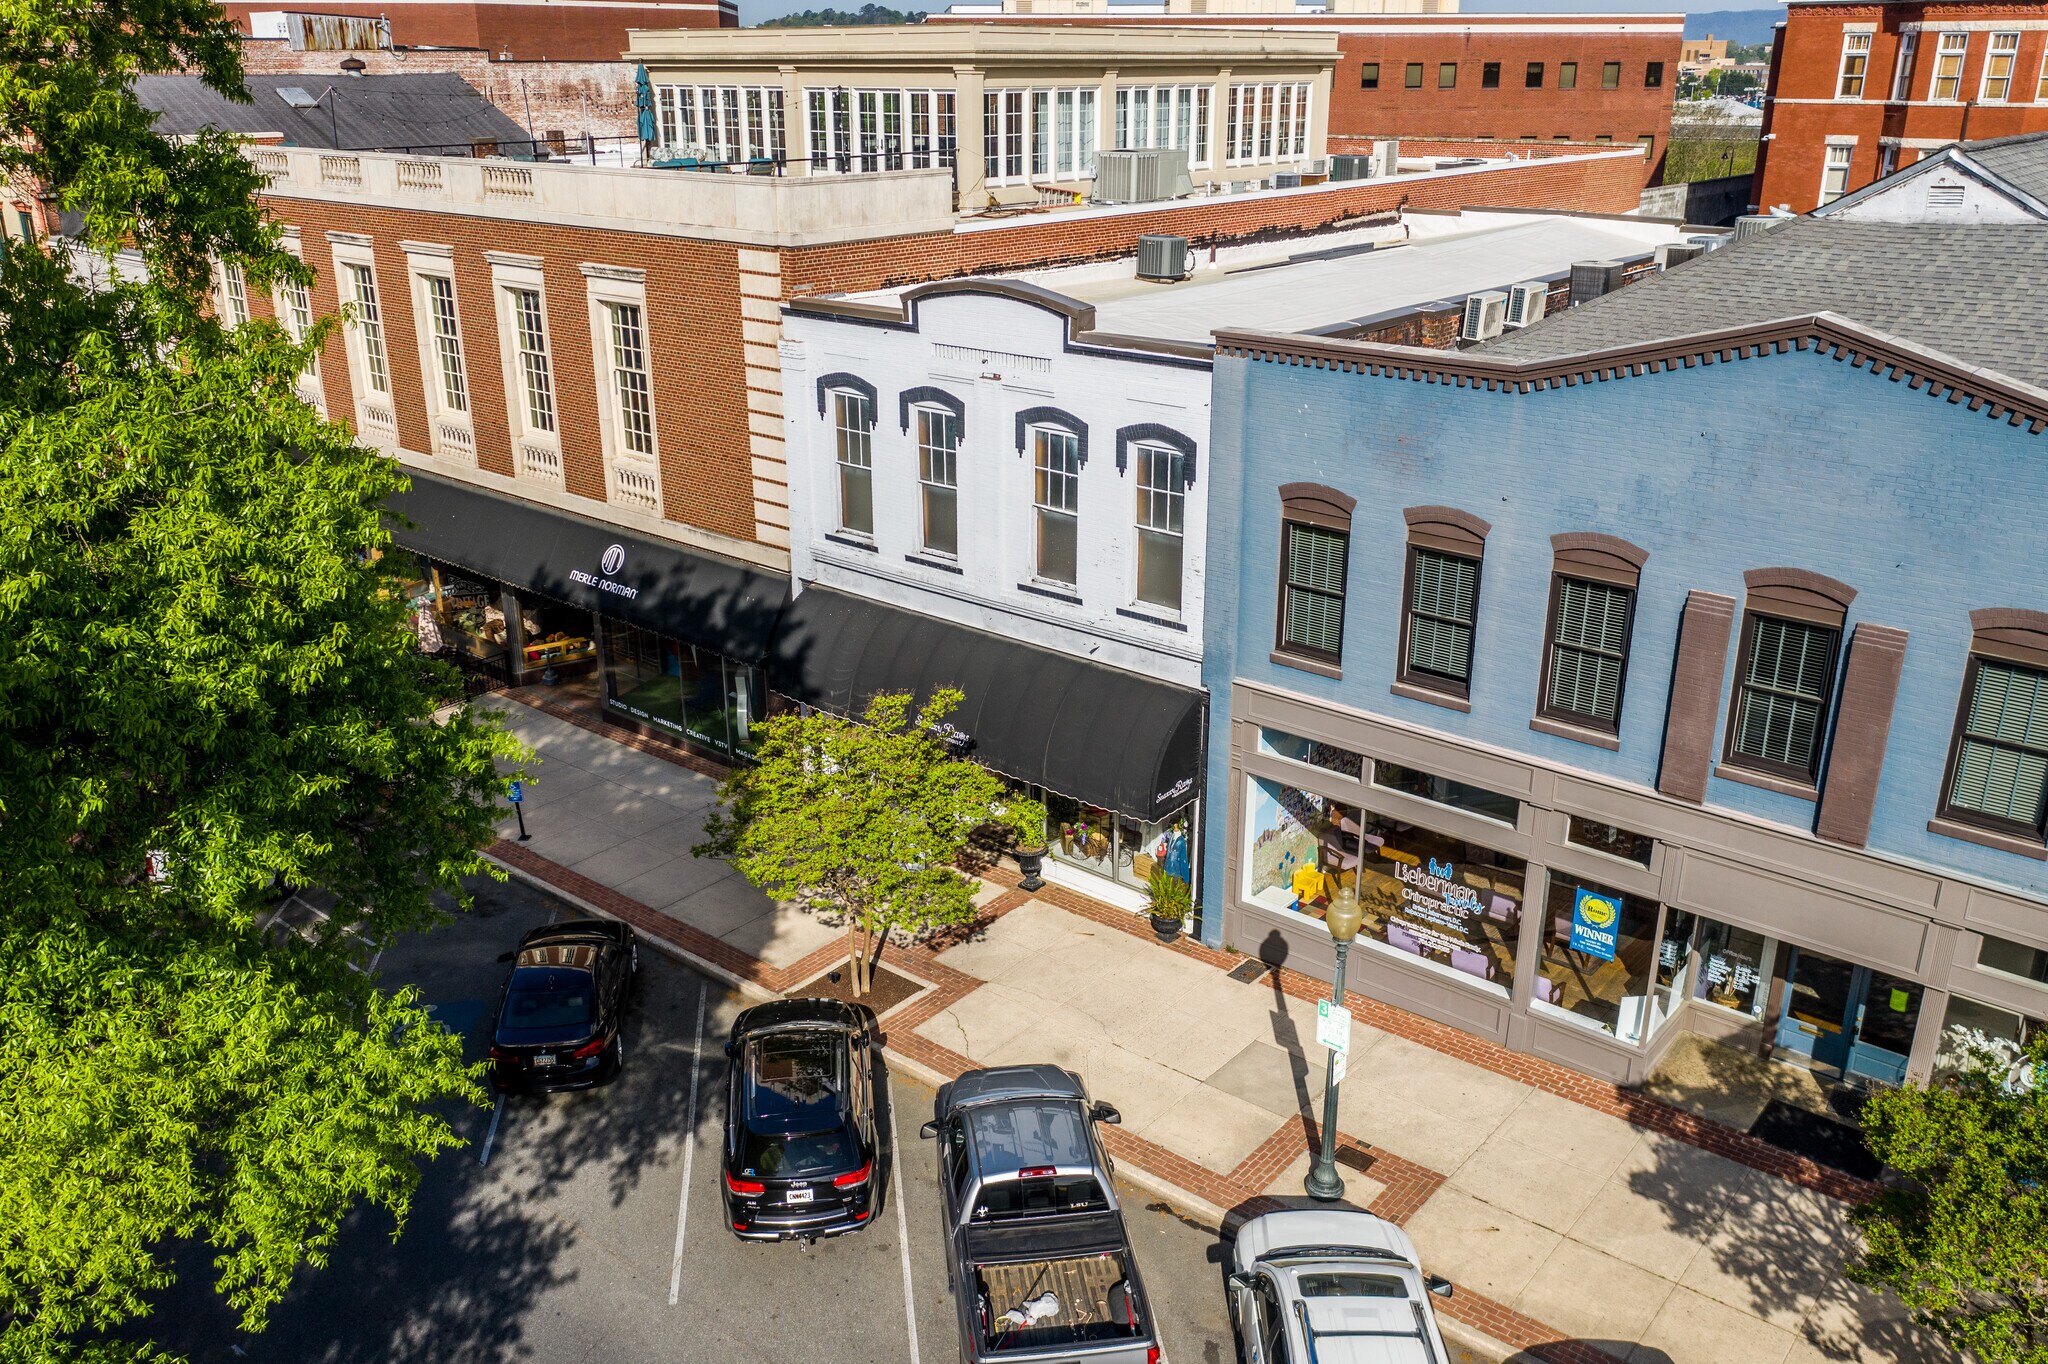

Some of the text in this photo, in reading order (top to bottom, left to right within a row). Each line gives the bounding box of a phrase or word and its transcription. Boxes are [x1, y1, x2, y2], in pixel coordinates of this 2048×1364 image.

[569, 569, 638, 600] MERLE NORMAN
[609, 698, 628, 711] STUDIO
[630, 706, 649, 719] DESIGN
[652, 716, 683, 732] MARKETING
[686, 728, 711, 743] CREATIVE
[1394, 861, 1477, 903] Lieberman
[1401, 887, 1470, 919] Chiropractic
[1442, 892, 1486, 915] Family
[1574, 923, 1614, 946] WINNER
[1320, 1003, 1327, 1015] 3
